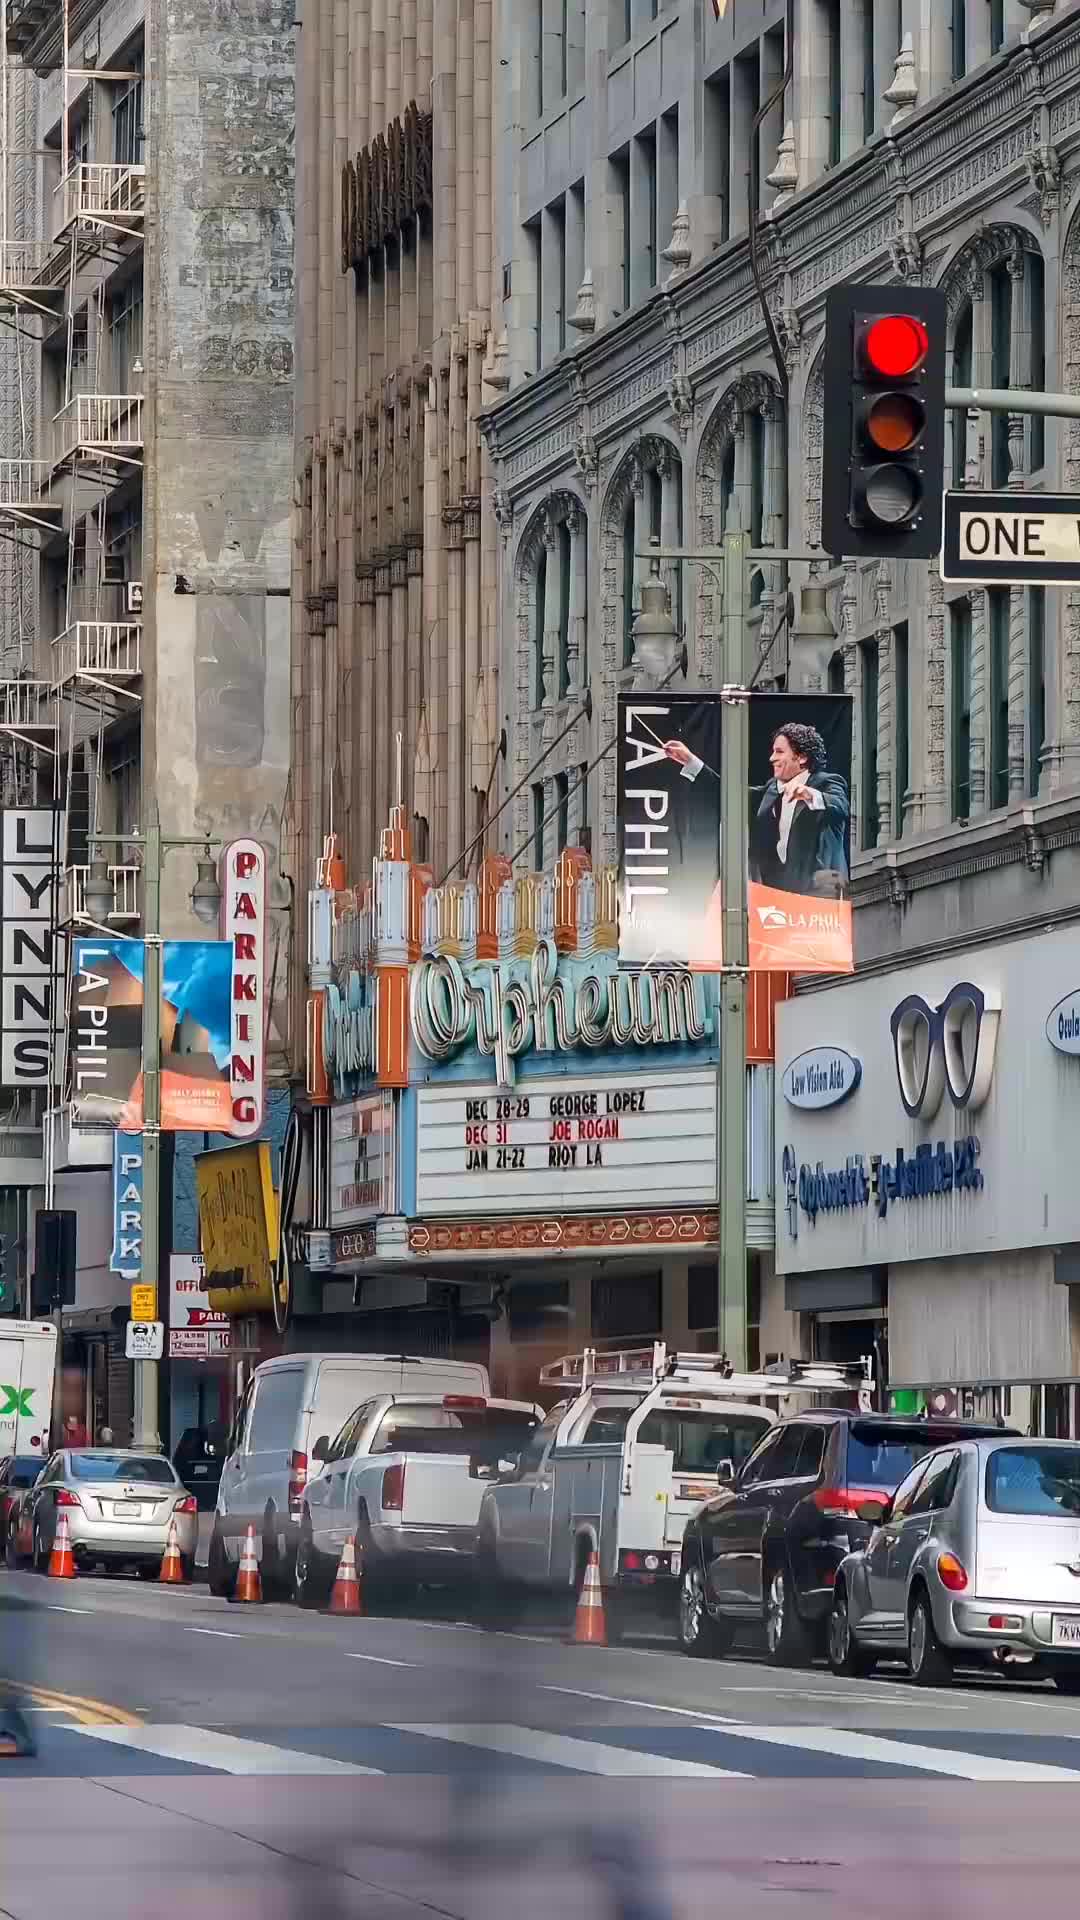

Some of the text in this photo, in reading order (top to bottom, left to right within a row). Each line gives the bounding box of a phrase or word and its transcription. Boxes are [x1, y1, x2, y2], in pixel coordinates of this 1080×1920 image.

[965, 517, 1045, 556] ONE
[625, 706, 670, 771] LA
[624, 789, 669, 913] PHIL
[12, 818, 55, 1078] LYNNS
[232, 852, 257, 1122] PARKING
[76, 948, 109, 1090] LA PHIL
[410, 940, 706, 1087] Orpheum
[465, 1091, 645, 1121] DEC 28-29 GEORGE LOPEZ
[791, 1060, 844, 1096] Low Vision Aids
[465, 1118, 619, 1145] DEC 31 JOE ROGAN
[466, 1143, 602, 1171] JAN 21-22 RIOT LA
[120, 1154, 142, 1259] PARK
